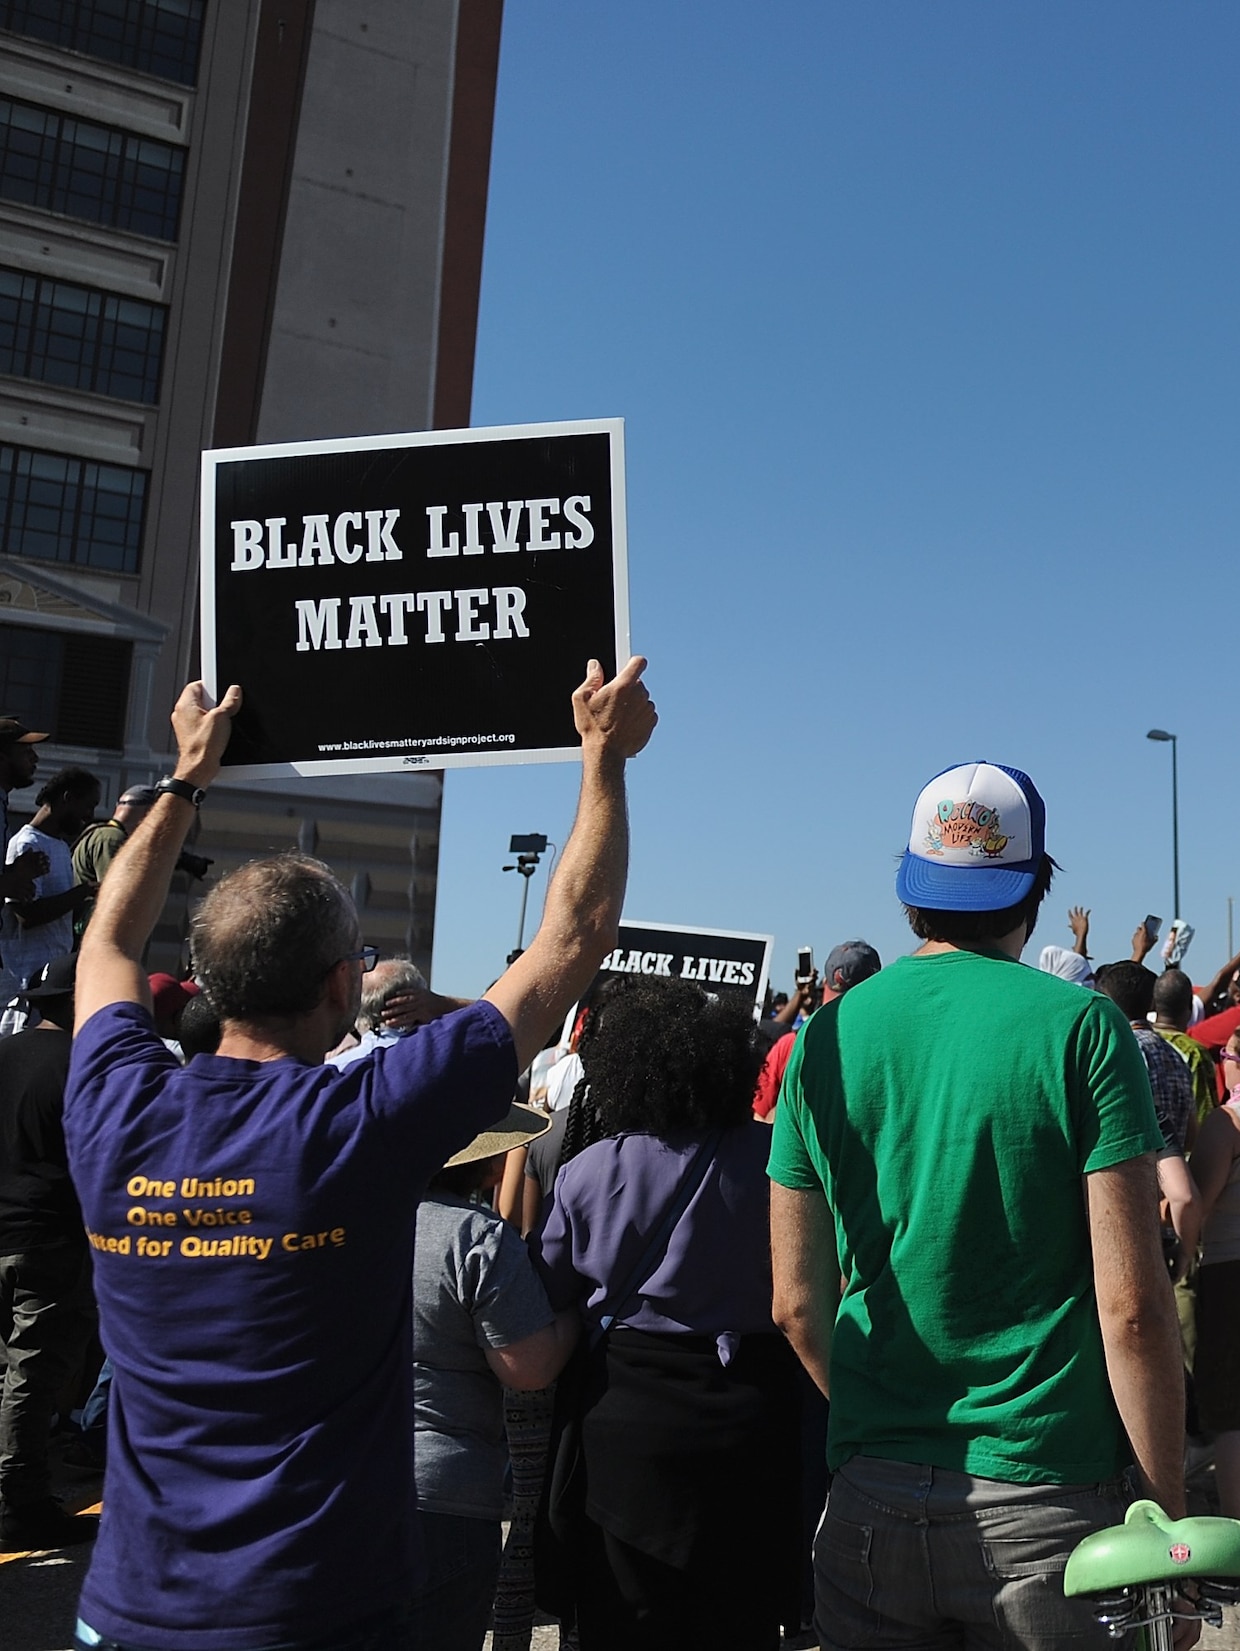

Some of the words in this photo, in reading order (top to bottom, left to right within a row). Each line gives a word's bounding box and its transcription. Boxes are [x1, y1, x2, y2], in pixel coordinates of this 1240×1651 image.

[231, 508, 403, 572] BLACK
[426, 495, 595, 559] LIVES
[295, 586, 530, 652] MATTER
[317, 732, 516, 752] www.blacklivesmatteryardsignproject.org
[680, 955, 755, 986] LIVES
[127, 1175, 176, 1198] One
[180, 1176, 256, 1199] Union
[127, 1206, 178, 1227] One
[182, 1207, 253, 1227] Voice
[136, 1235, 174, 1257] for
[179, 1235, 274, 1260] Quality
[281, 1226, 347, 1252] Care
